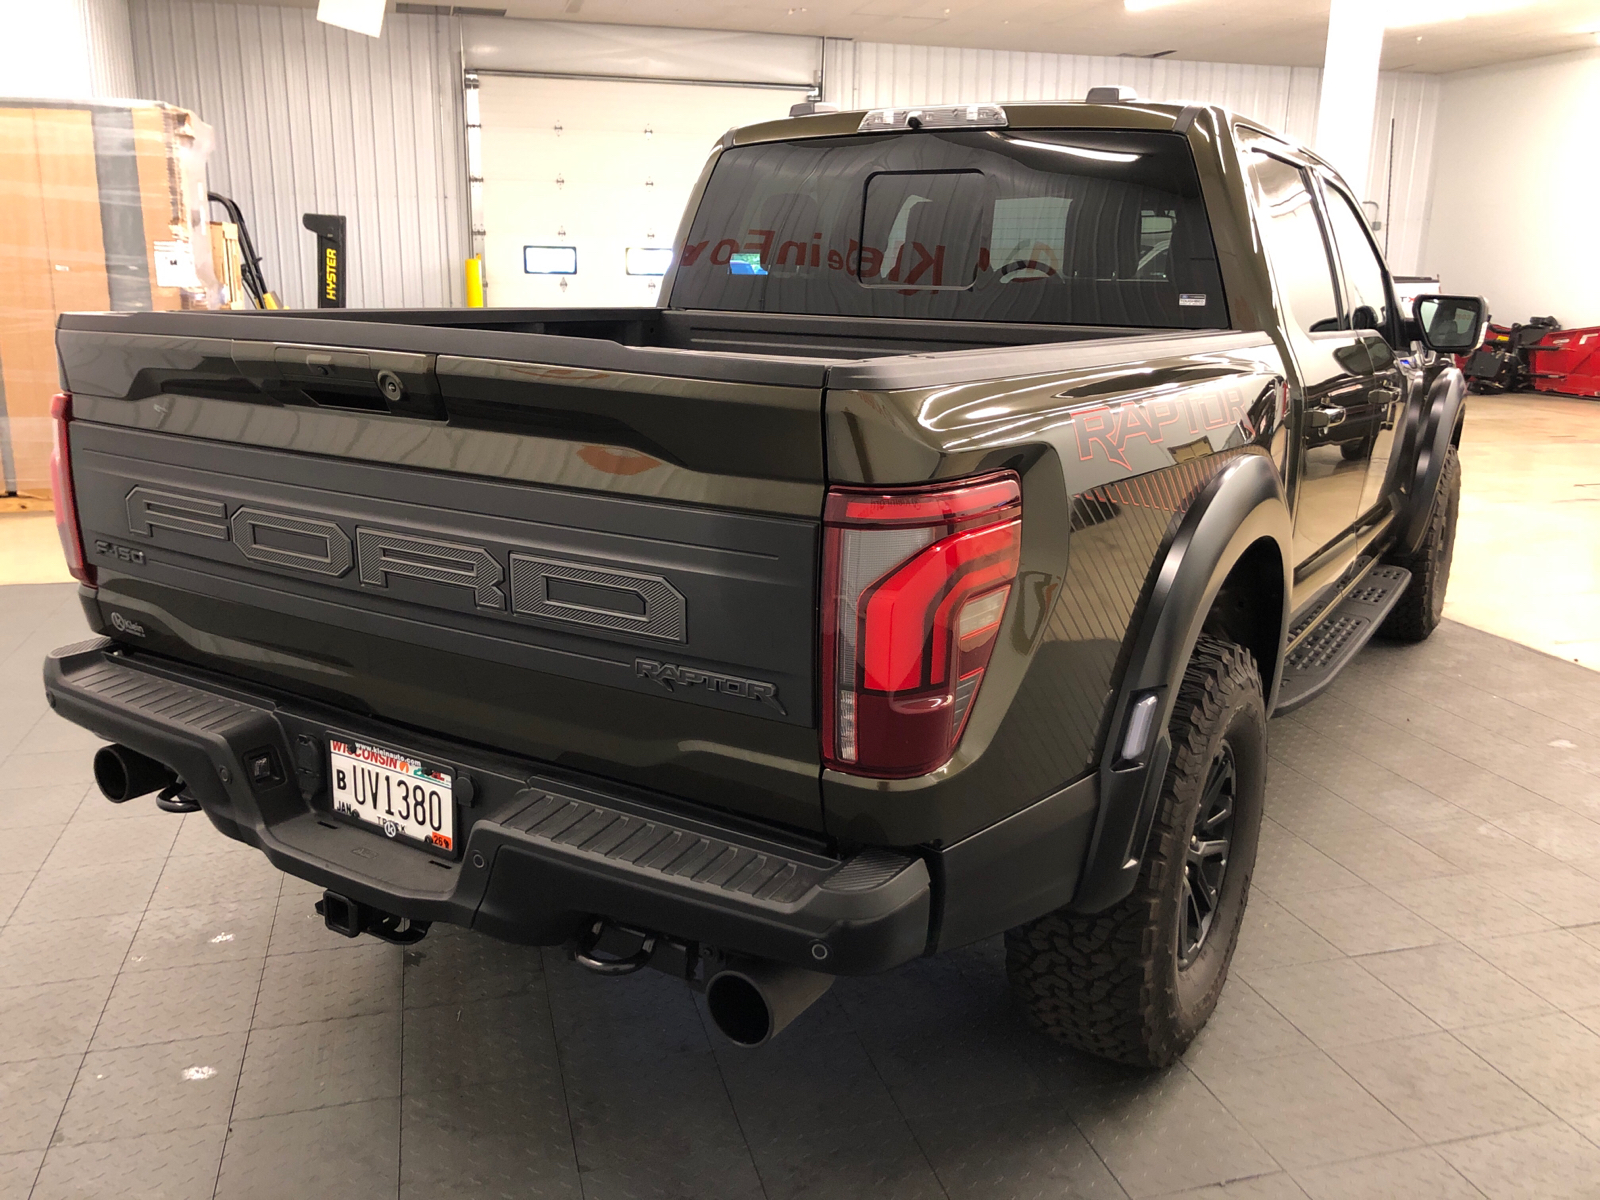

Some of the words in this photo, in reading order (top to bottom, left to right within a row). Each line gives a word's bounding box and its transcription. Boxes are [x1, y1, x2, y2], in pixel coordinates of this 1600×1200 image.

[325, 247, 338, 301] HYSTER
[1070, 386, 1256, 471] RAPTOR
[125, 485, 688, 645] FORD
[635, 657, 787, 716] RAPTOR
[355, 742, 421, 767] www.kleinauto.com
[336, 768, 347, 791] B
[353, 765, 442, 831] UV1380
[337, 801, 352, 815] JAN
[433, 834, 444, 848] 26
